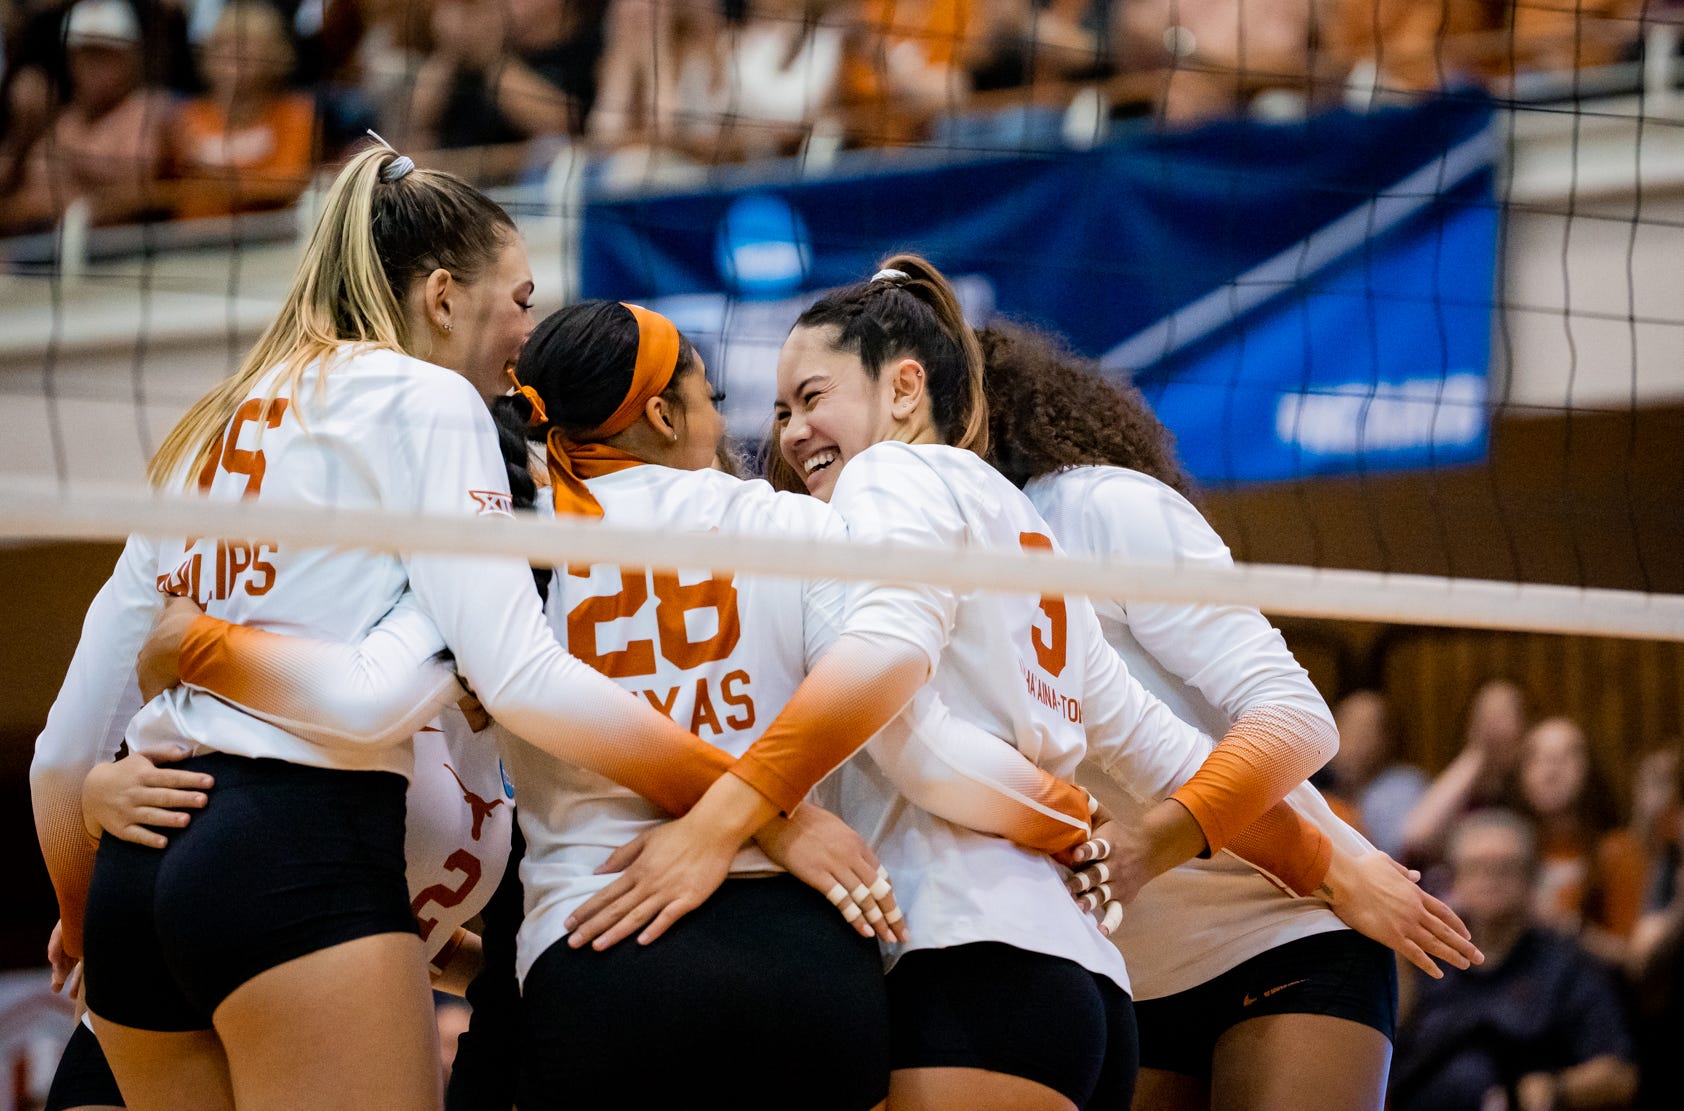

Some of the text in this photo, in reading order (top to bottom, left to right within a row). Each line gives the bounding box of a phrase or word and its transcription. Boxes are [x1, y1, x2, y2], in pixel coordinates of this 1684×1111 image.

[567, 560, 741, 678] 28
[1019, 531, 1067, 678] 3
[411, 848, 482, 943] 2
